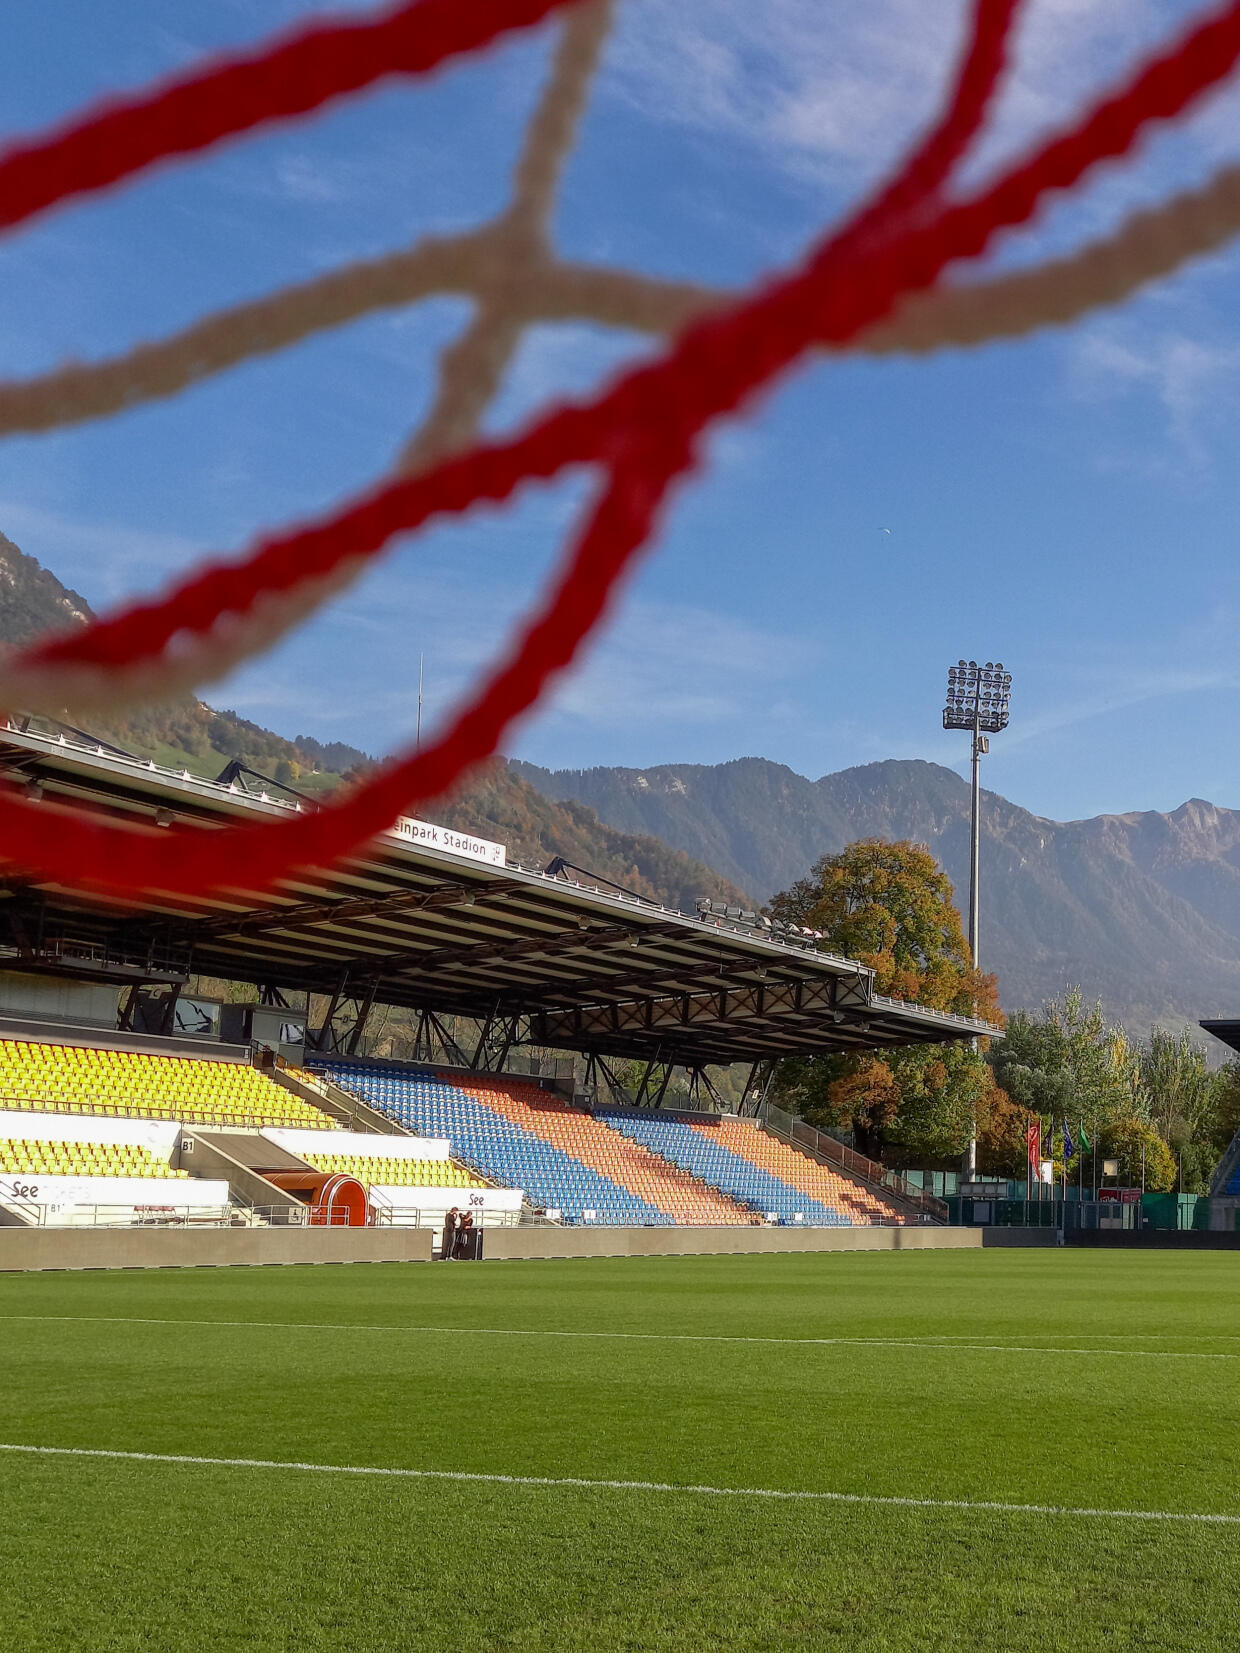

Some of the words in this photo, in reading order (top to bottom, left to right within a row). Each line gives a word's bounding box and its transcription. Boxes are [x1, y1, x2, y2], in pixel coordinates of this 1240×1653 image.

[394, 818, 438, 842] einpark
[444, 832, 486, 855] Stadion
[182, 1141, 193, 1151] B1
[11, 1181, 39, 1198] See
[469, 1193, 485, 1206] See
